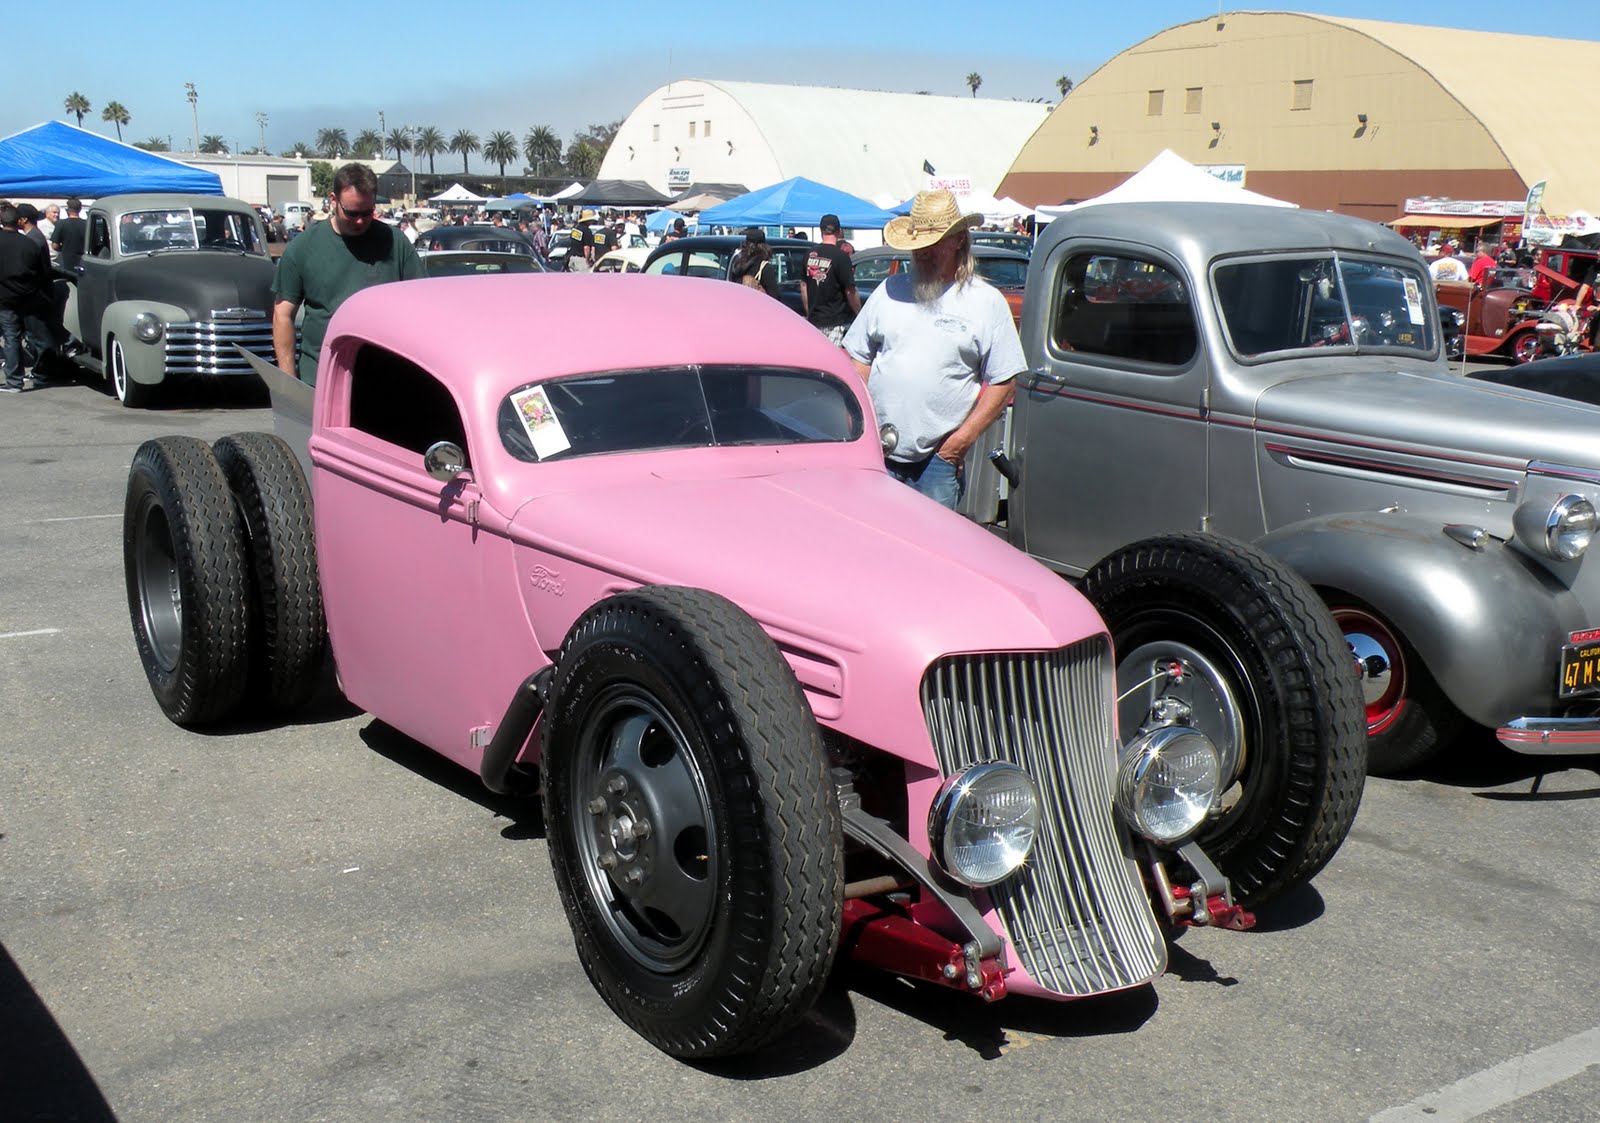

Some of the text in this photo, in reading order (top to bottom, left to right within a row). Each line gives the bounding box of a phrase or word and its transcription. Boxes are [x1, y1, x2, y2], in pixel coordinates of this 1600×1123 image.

[930, 179, 970, 190] SUNGLASSES
[1226, 169, 1243, 182] Hall
[530, 564, 565, 598] Ford
[1565, 661, 1580, 687] 47
[1583, 659, 1594, 685] M
